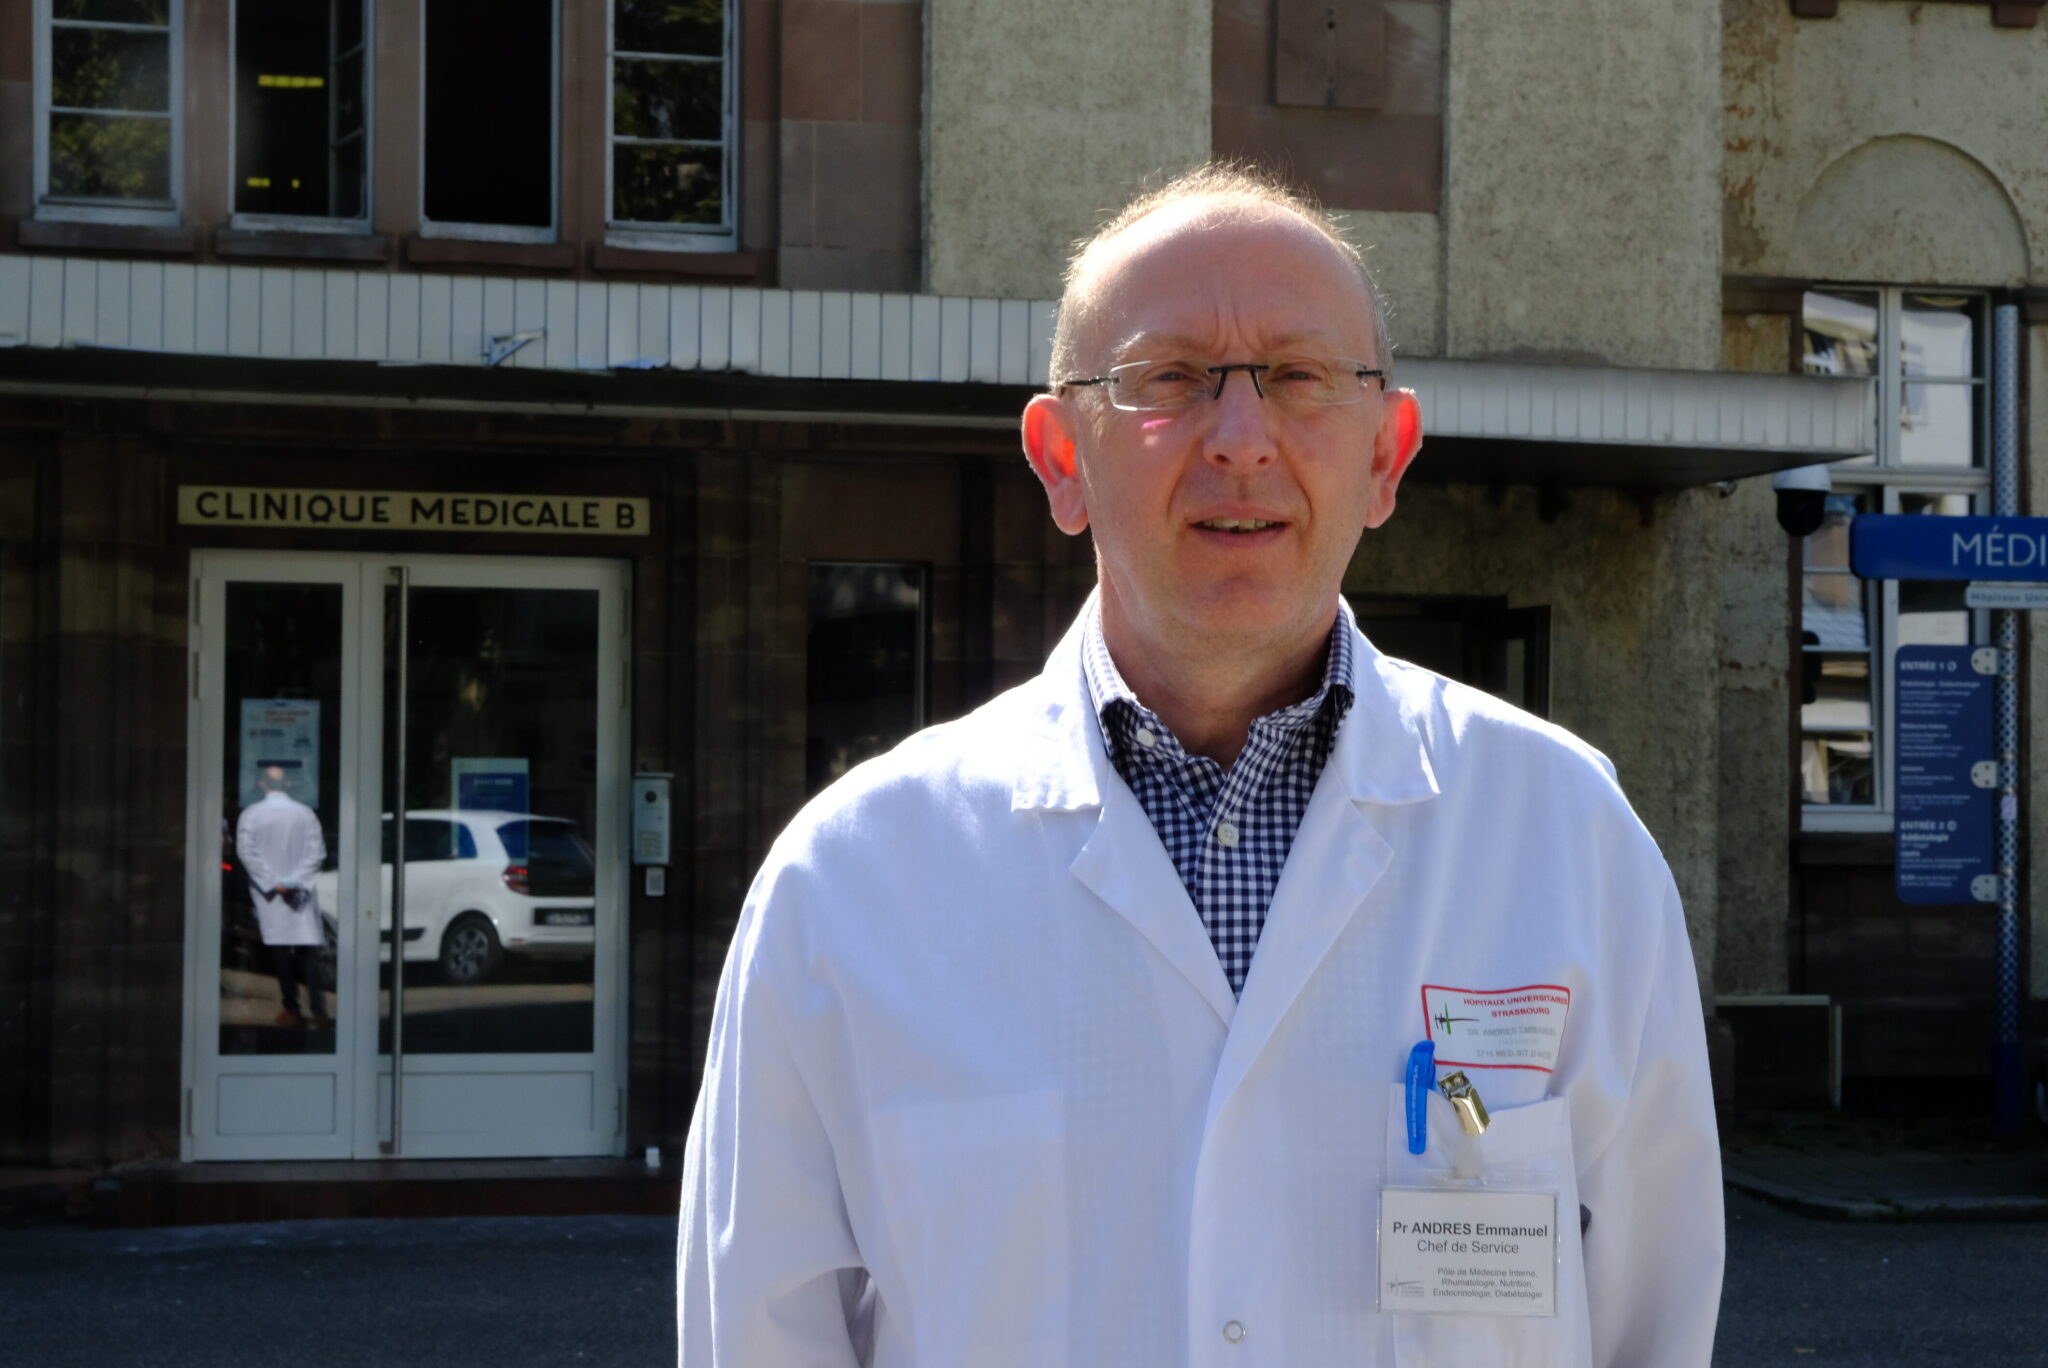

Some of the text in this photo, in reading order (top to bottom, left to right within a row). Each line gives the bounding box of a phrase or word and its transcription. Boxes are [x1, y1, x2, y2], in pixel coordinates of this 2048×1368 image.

[195, 491, 635, 529] CLINIQUE MEDICALE B
[1952, 523, 2046, 567] MÉDI
[1506, 994, 1568, 1005] UNIVERSITAIRES
[1491, 1007, 1550, 1018] STRASBOURG
[1392, 1221, 1548, 1237] Pr ANDRES Emmanuel
[1417, 1240, 1519, 1254] Chef de Service
[1437, 1266, 1455, 1276] Pôle
[1457, 1267, 1467, 1276] de
[1469, 1267, 1507, 1276] Médecine
[1495, 1289, 1543, 1300] Diabétologie
